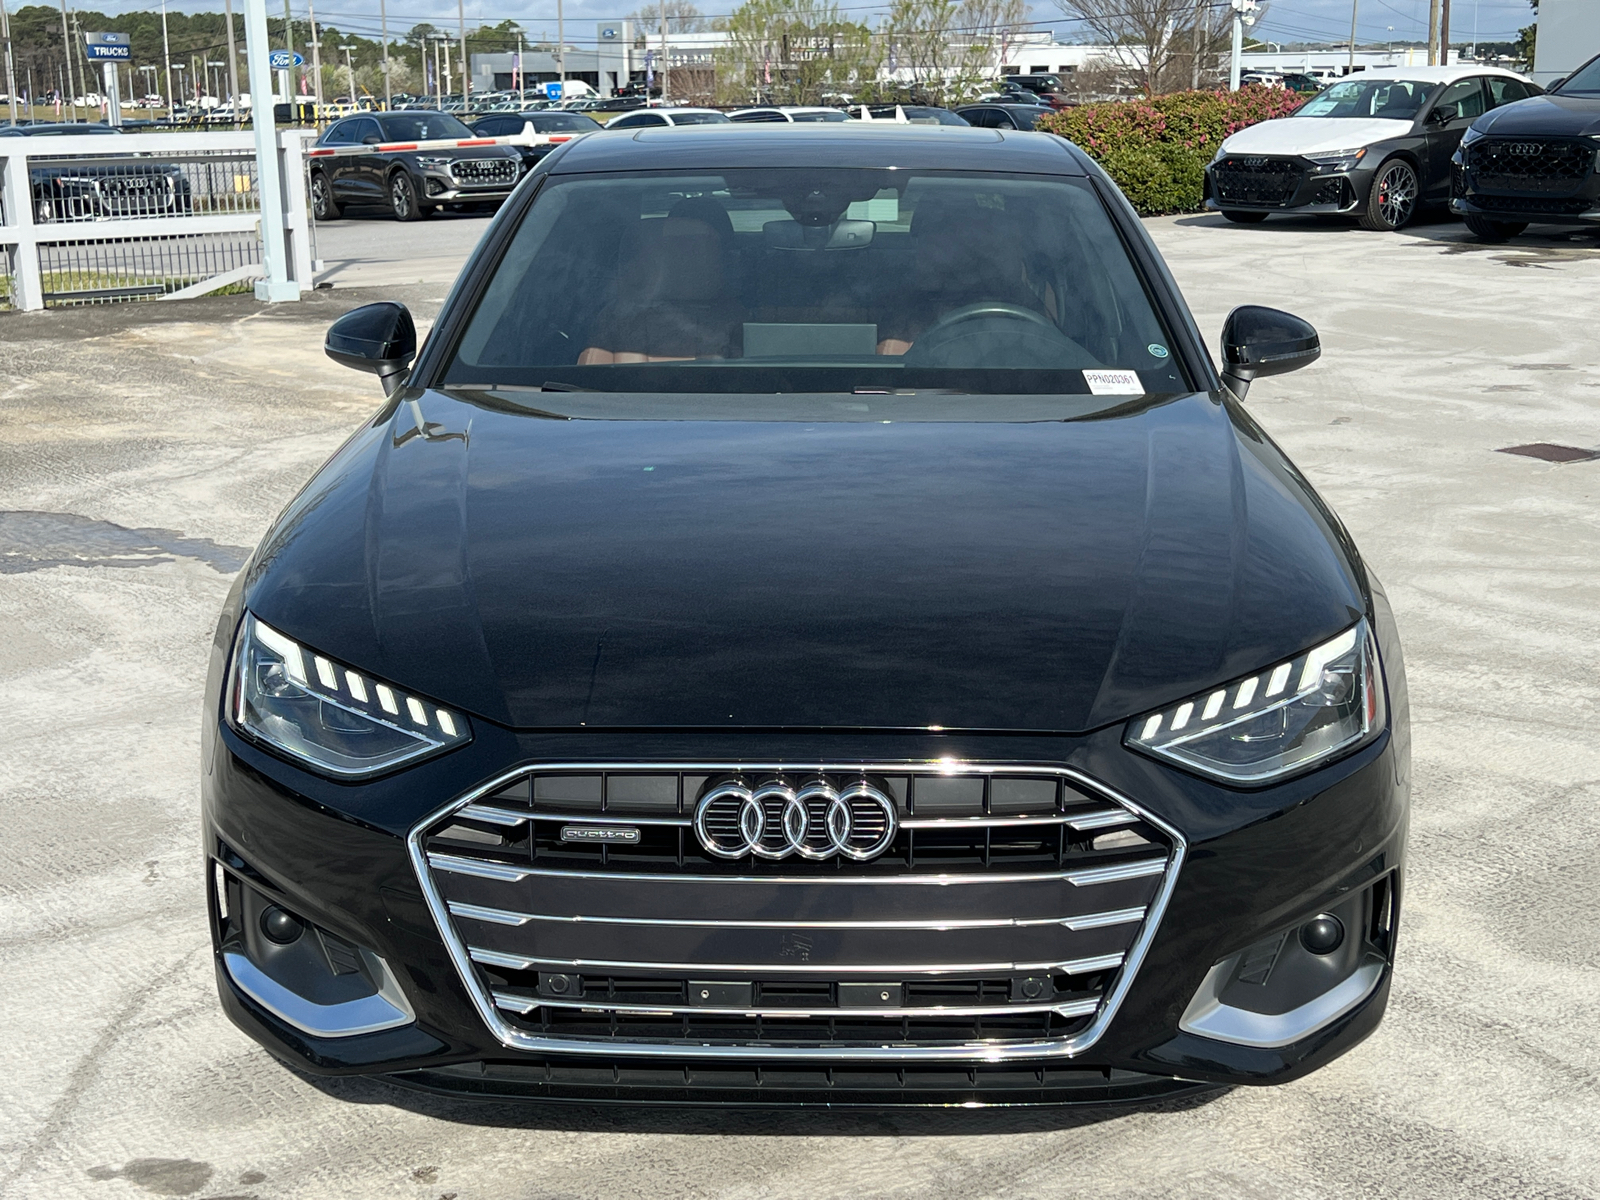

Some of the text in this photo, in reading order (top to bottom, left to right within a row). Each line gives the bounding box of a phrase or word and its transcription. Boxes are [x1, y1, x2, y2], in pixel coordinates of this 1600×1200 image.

[93, 46, 129, 57] TRUCKS
[1086, 374, 1135, 384] PPN020361
[566, 830, 636, 839] quattro
